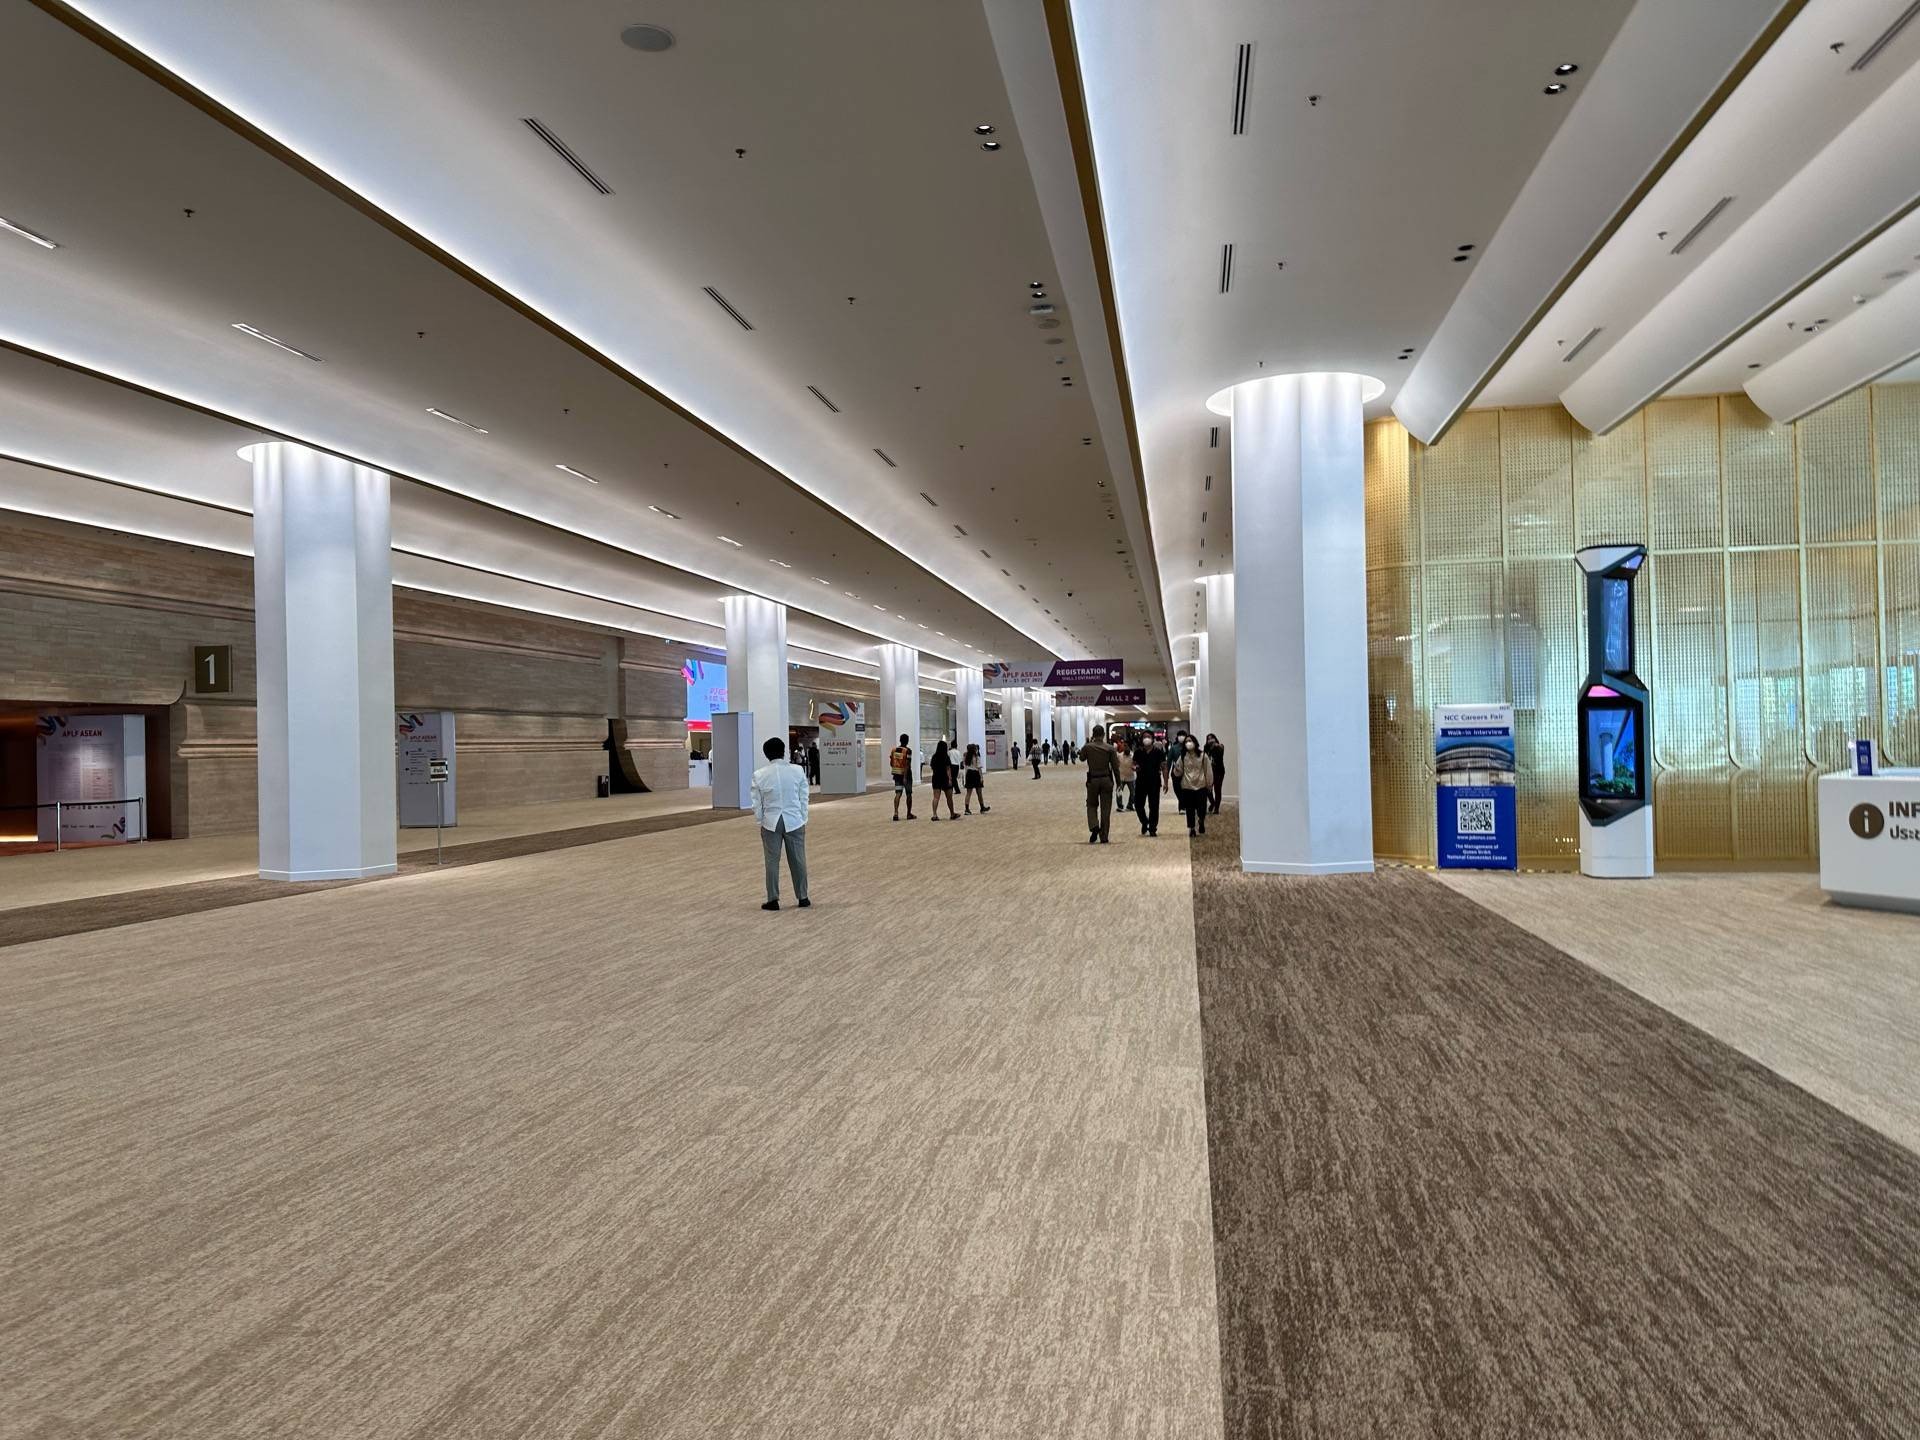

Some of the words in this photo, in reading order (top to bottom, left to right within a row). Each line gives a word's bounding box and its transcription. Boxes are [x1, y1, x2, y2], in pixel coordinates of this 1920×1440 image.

[204, 653, 215, 685] 1
[1056, 667, 1107, 676] REGISTRATION
[1105, 695, 1124, 703] HALL
[1461, 713, 1488, 721] Careers
[1490, 712, 1504, 720] Fair
[80, 729, 103, 737] ASEAN
[1447, 729, 1472, 737] Walk-in
[1473, 728, 1503, 736] Interview
[1888, 800, 1920, 819] INF
